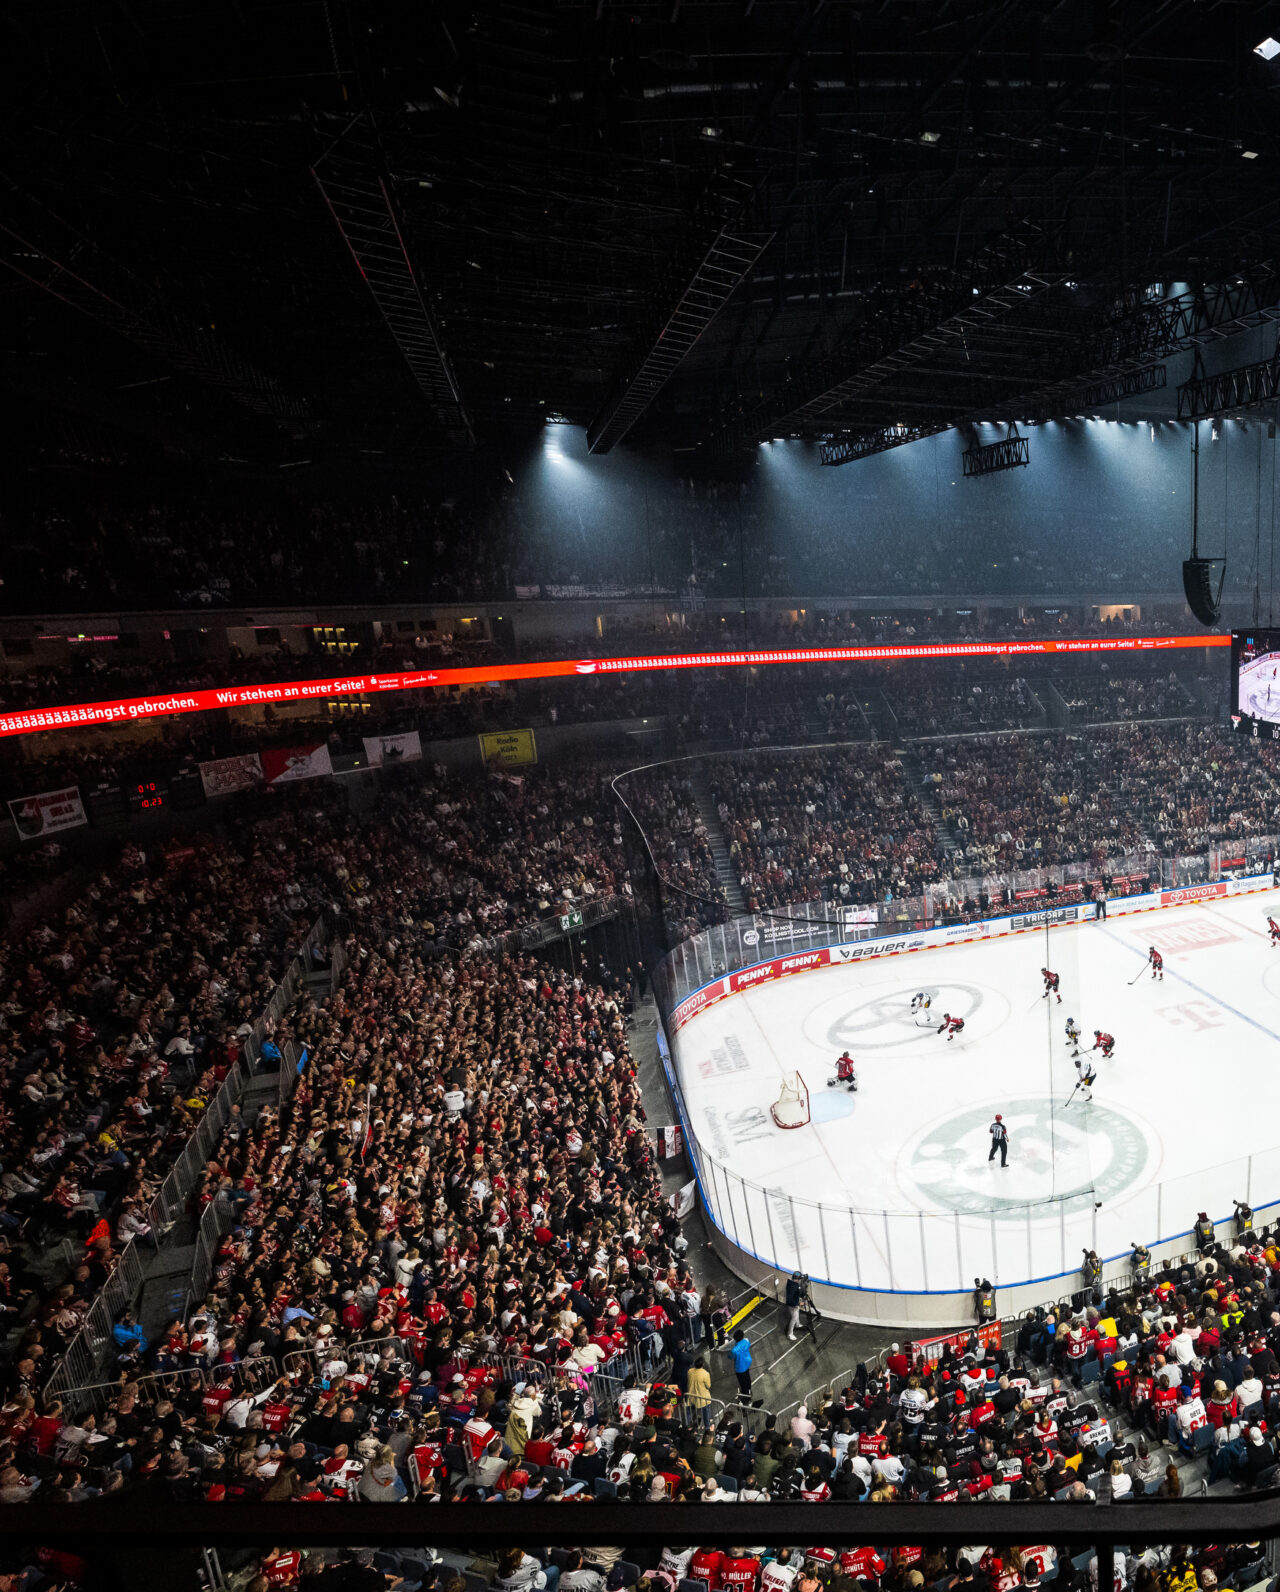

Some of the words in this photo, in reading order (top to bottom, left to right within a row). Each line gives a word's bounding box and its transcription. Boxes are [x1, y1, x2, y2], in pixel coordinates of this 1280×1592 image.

[1008, 643, 1046, 653] gebrochen.
[1055, 642, 1069, 650] Wir
[1117, 640, 1135, 648] Seite!
[217, 691, 237, 703] Wir
[240, 689, 282, 701] stehen
[284, 687, 299, 697] an
[302, 685, 332, 695] eurer
[333, 679, 365, 692] Seite!
[129, 697, 199, 717] gebrochen.
[1253, 727, 1258, 737] 0
[496, 736, 519, 745] Radio
[1186, 886, 1218, 899] TOYOTA
[1026, 910, 1064, 923] TRICORP
[679, 993, 707, 1018] TOYOTA
[1071, 1344, 1086, 1354] 91
[1023, 1546, 1048, 1557] THORNBURY
[728, 1571, 752, 1581] MÜLLER
